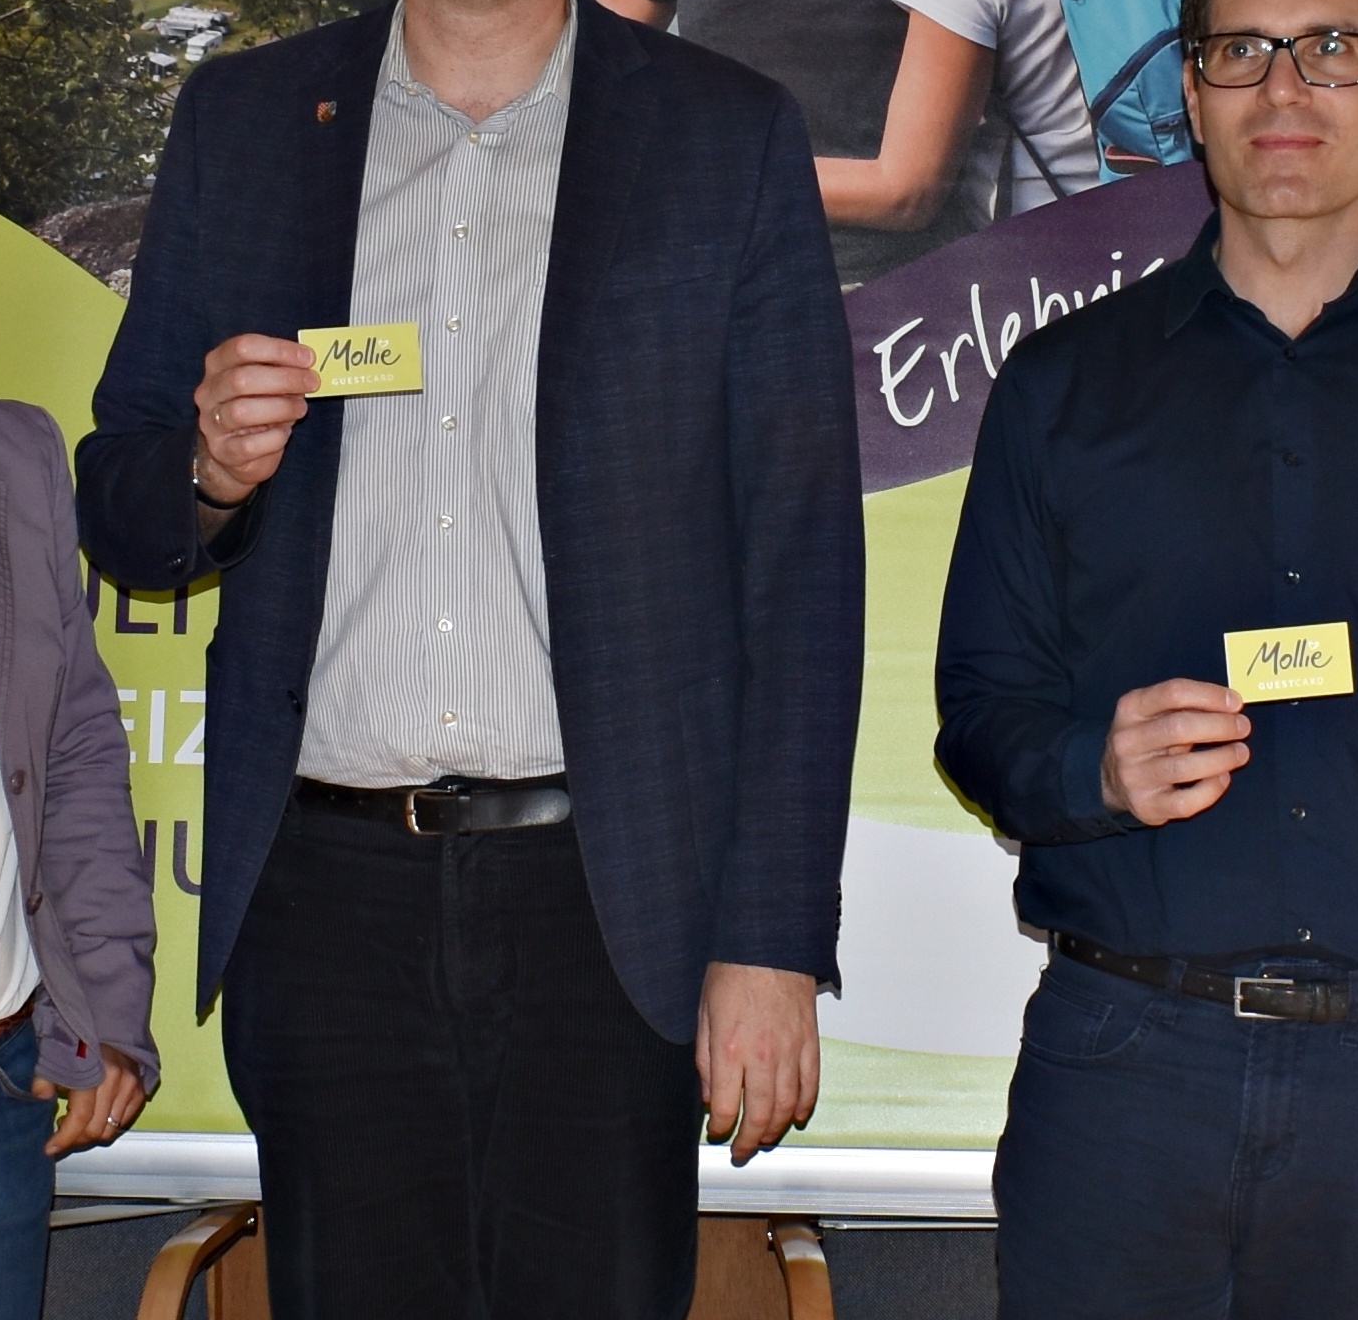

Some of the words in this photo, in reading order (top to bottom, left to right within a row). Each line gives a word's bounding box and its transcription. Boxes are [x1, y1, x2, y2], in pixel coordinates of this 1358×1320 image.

[319, 337, 402, 372] Mollie
[331, 373, 395, 386] GUESTCARD
[1246, 638, 1333, 676] Mollie
[1257, 676, 1325, 690] GUESTCARD
